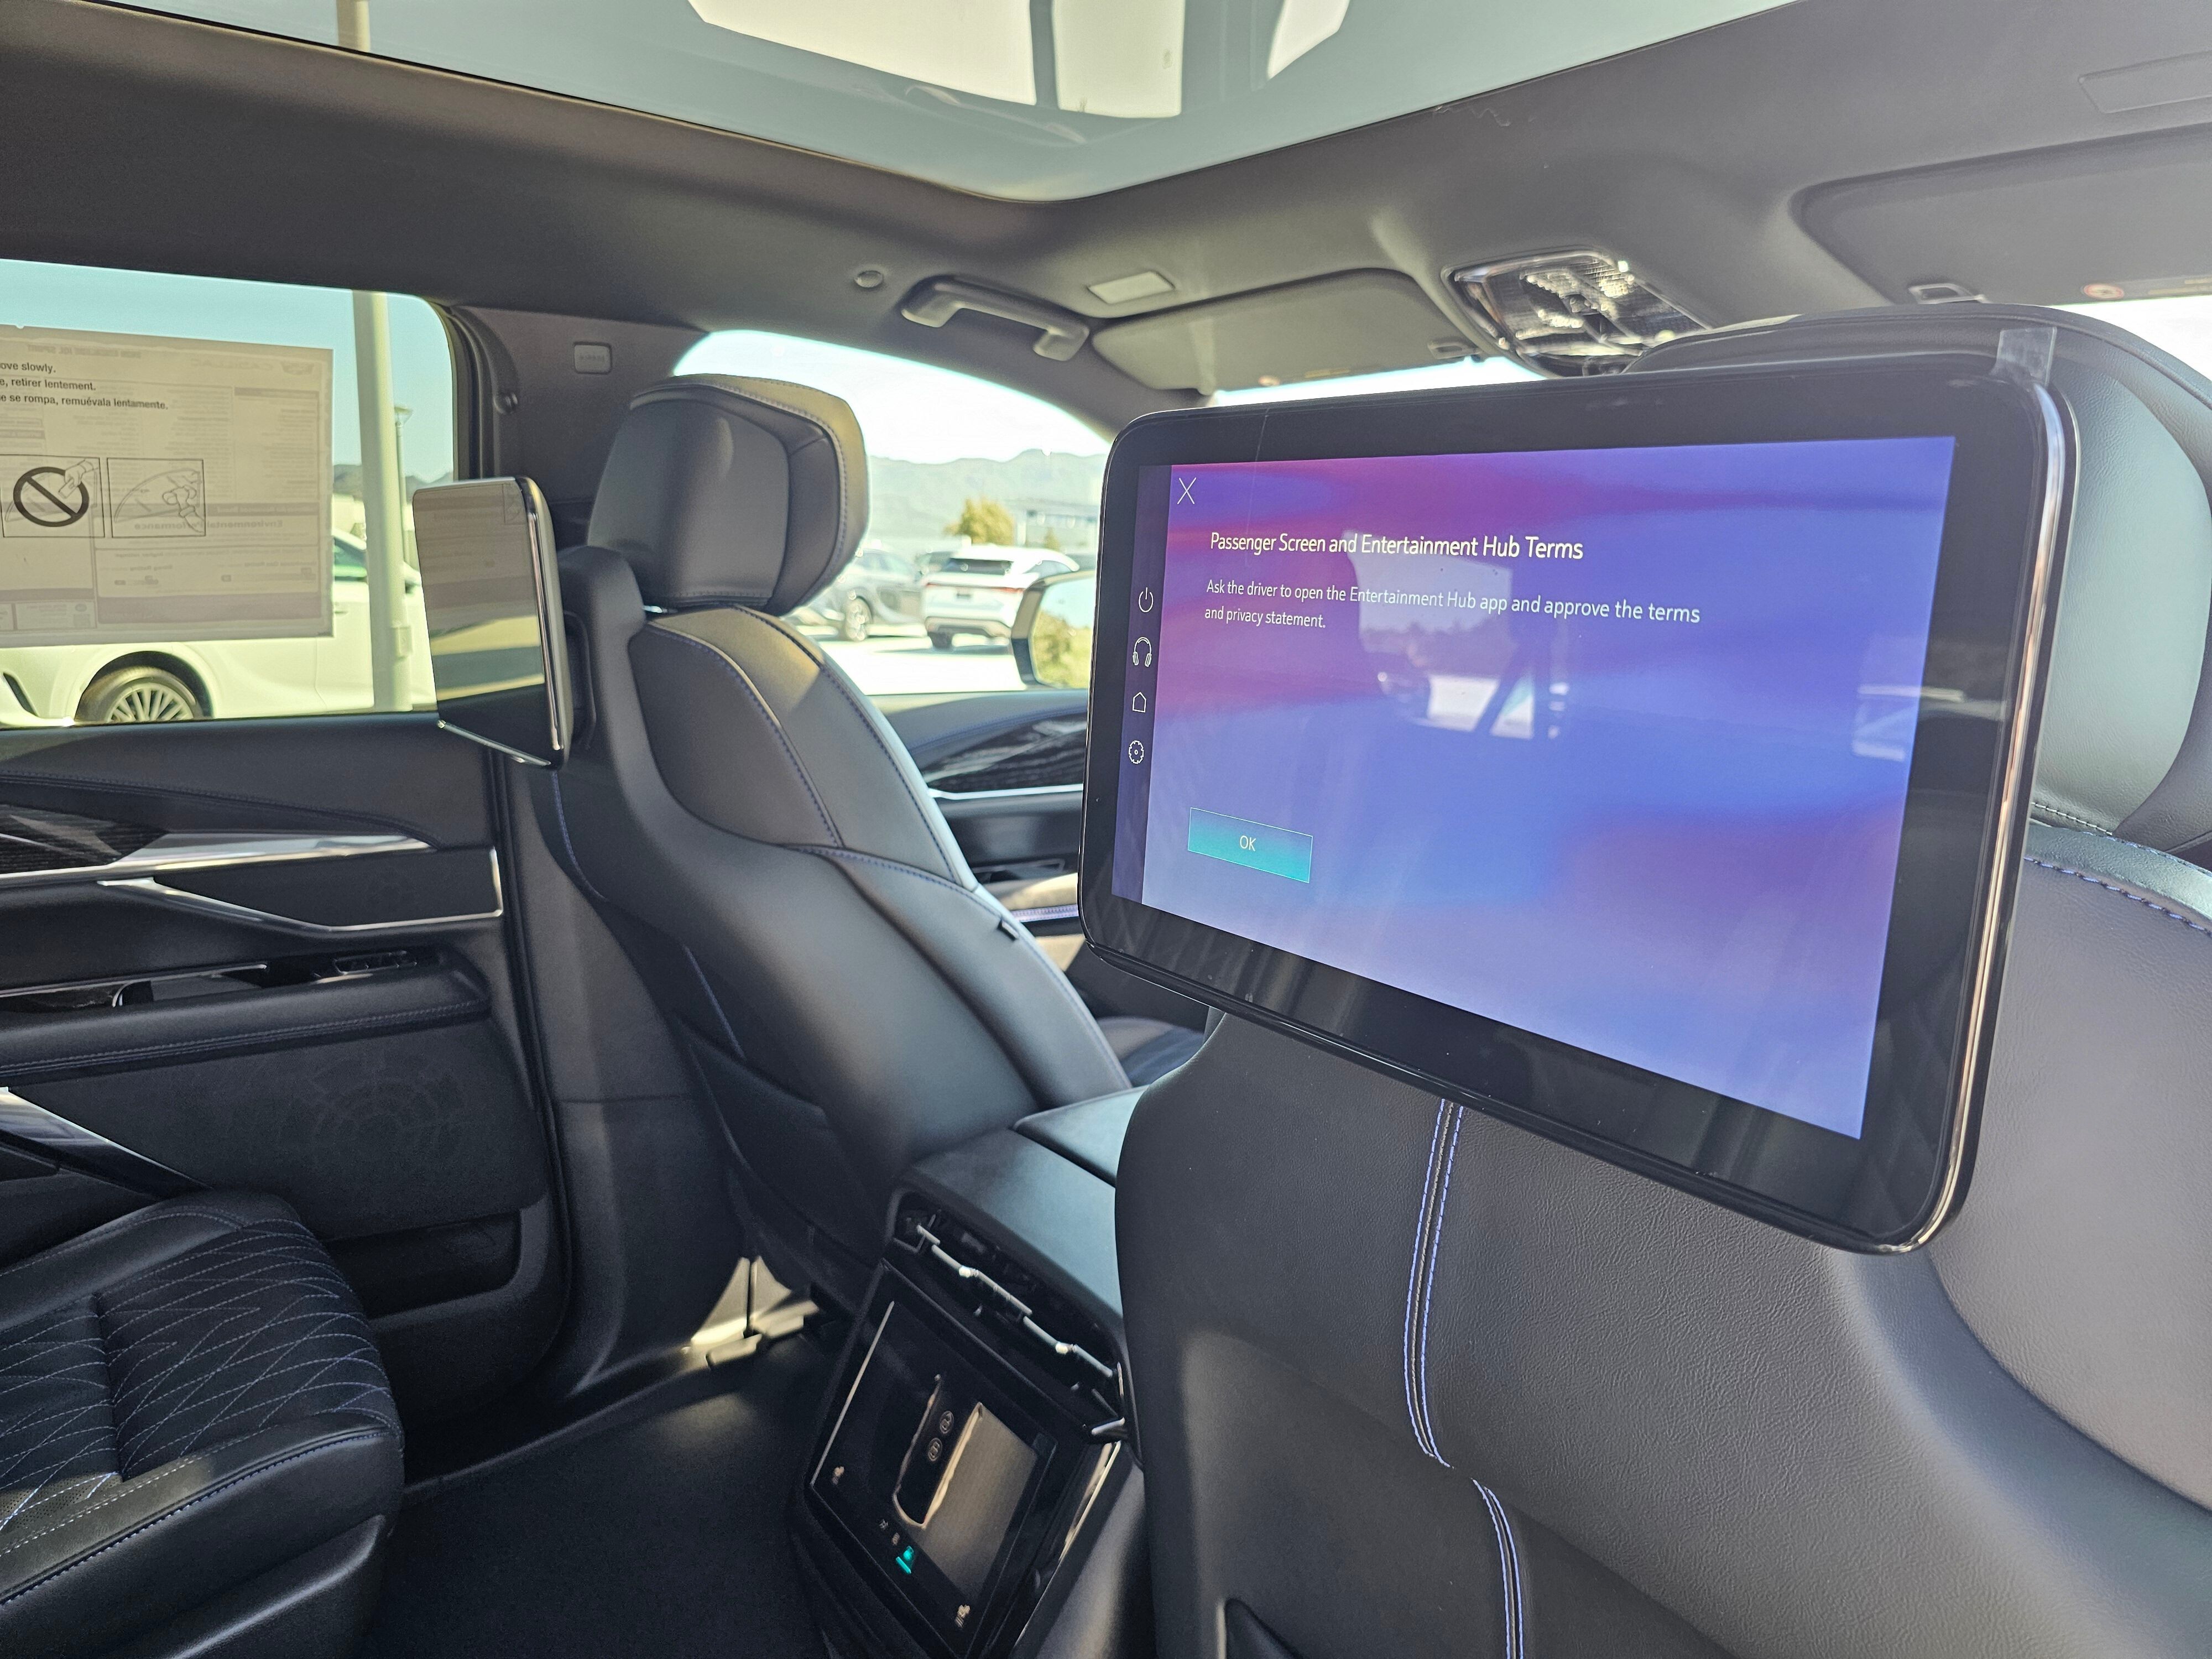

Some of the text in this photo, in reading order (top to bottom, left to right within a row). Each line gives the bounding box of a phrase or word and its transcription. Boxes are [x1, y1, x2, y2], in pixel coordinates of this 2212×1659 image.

[22, 362, 56, 374] slowly.
[11, 378, 41, 388] retirer
[44, 379, 96, 390] lentement.
[24, 395, 58, 406] rompa,
[61, 397, 111, 407] remuévala
[1210, 532, 1584, 560] Passenger Screen and Entertainment Hub Terms
[1206, 579, 1700, 624] Ask the driver to open the Entertainment Hub app and approve the terms
[1204, 606, 1326, 629] and privacy statement.
[1239, 835, 1256, 852] OK
